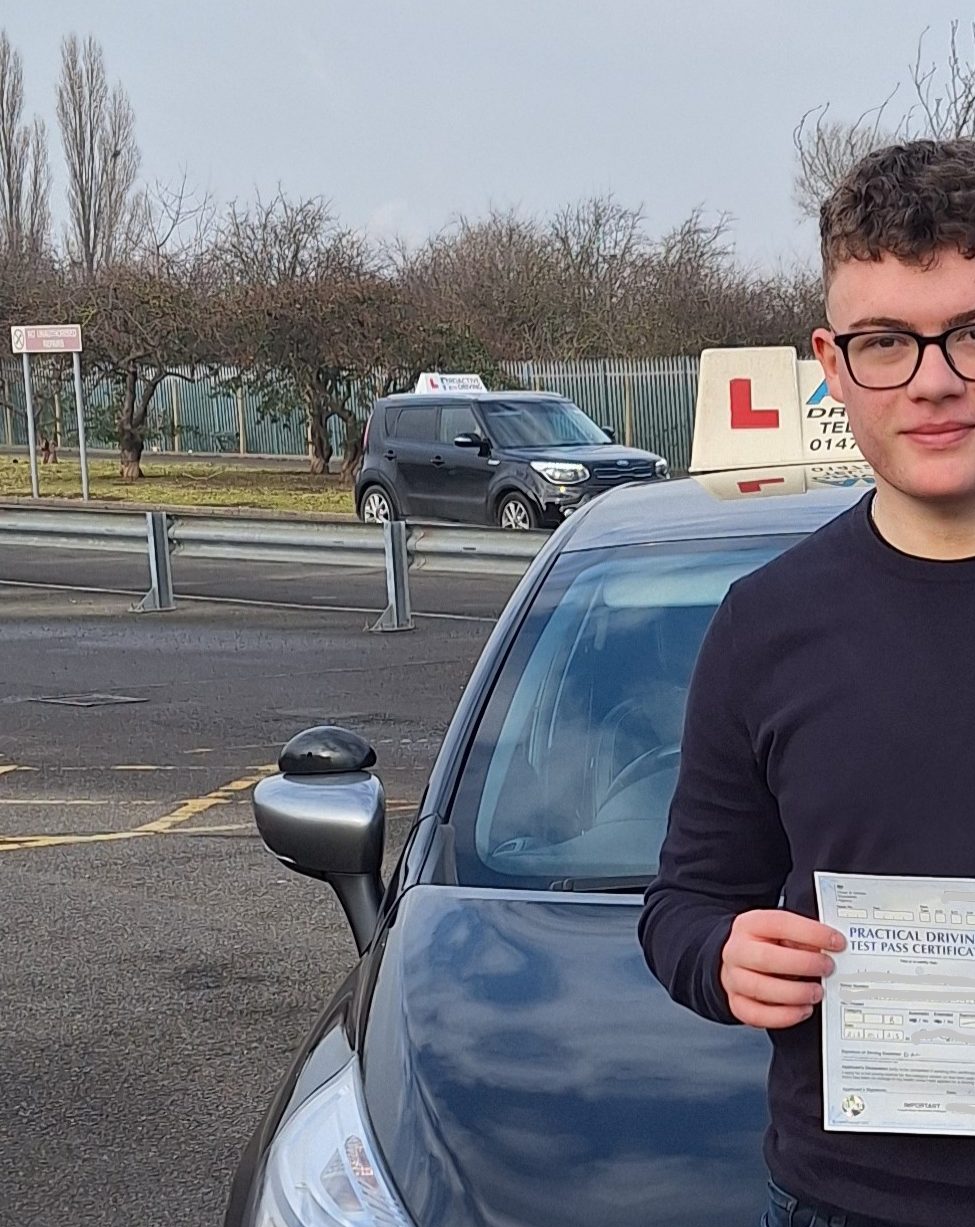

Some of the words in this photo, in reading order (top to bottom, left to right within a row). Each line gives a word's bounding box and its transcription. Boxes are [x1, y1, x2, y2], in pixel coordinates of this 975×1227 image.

[730, 378, 779, 429] L
[809, 438, 857, 451] 0147
[849, 927, 921, 942] PRACTICAL
[850, 940, 877, 952] TEST
[881, 942, 909, 954] PASS
